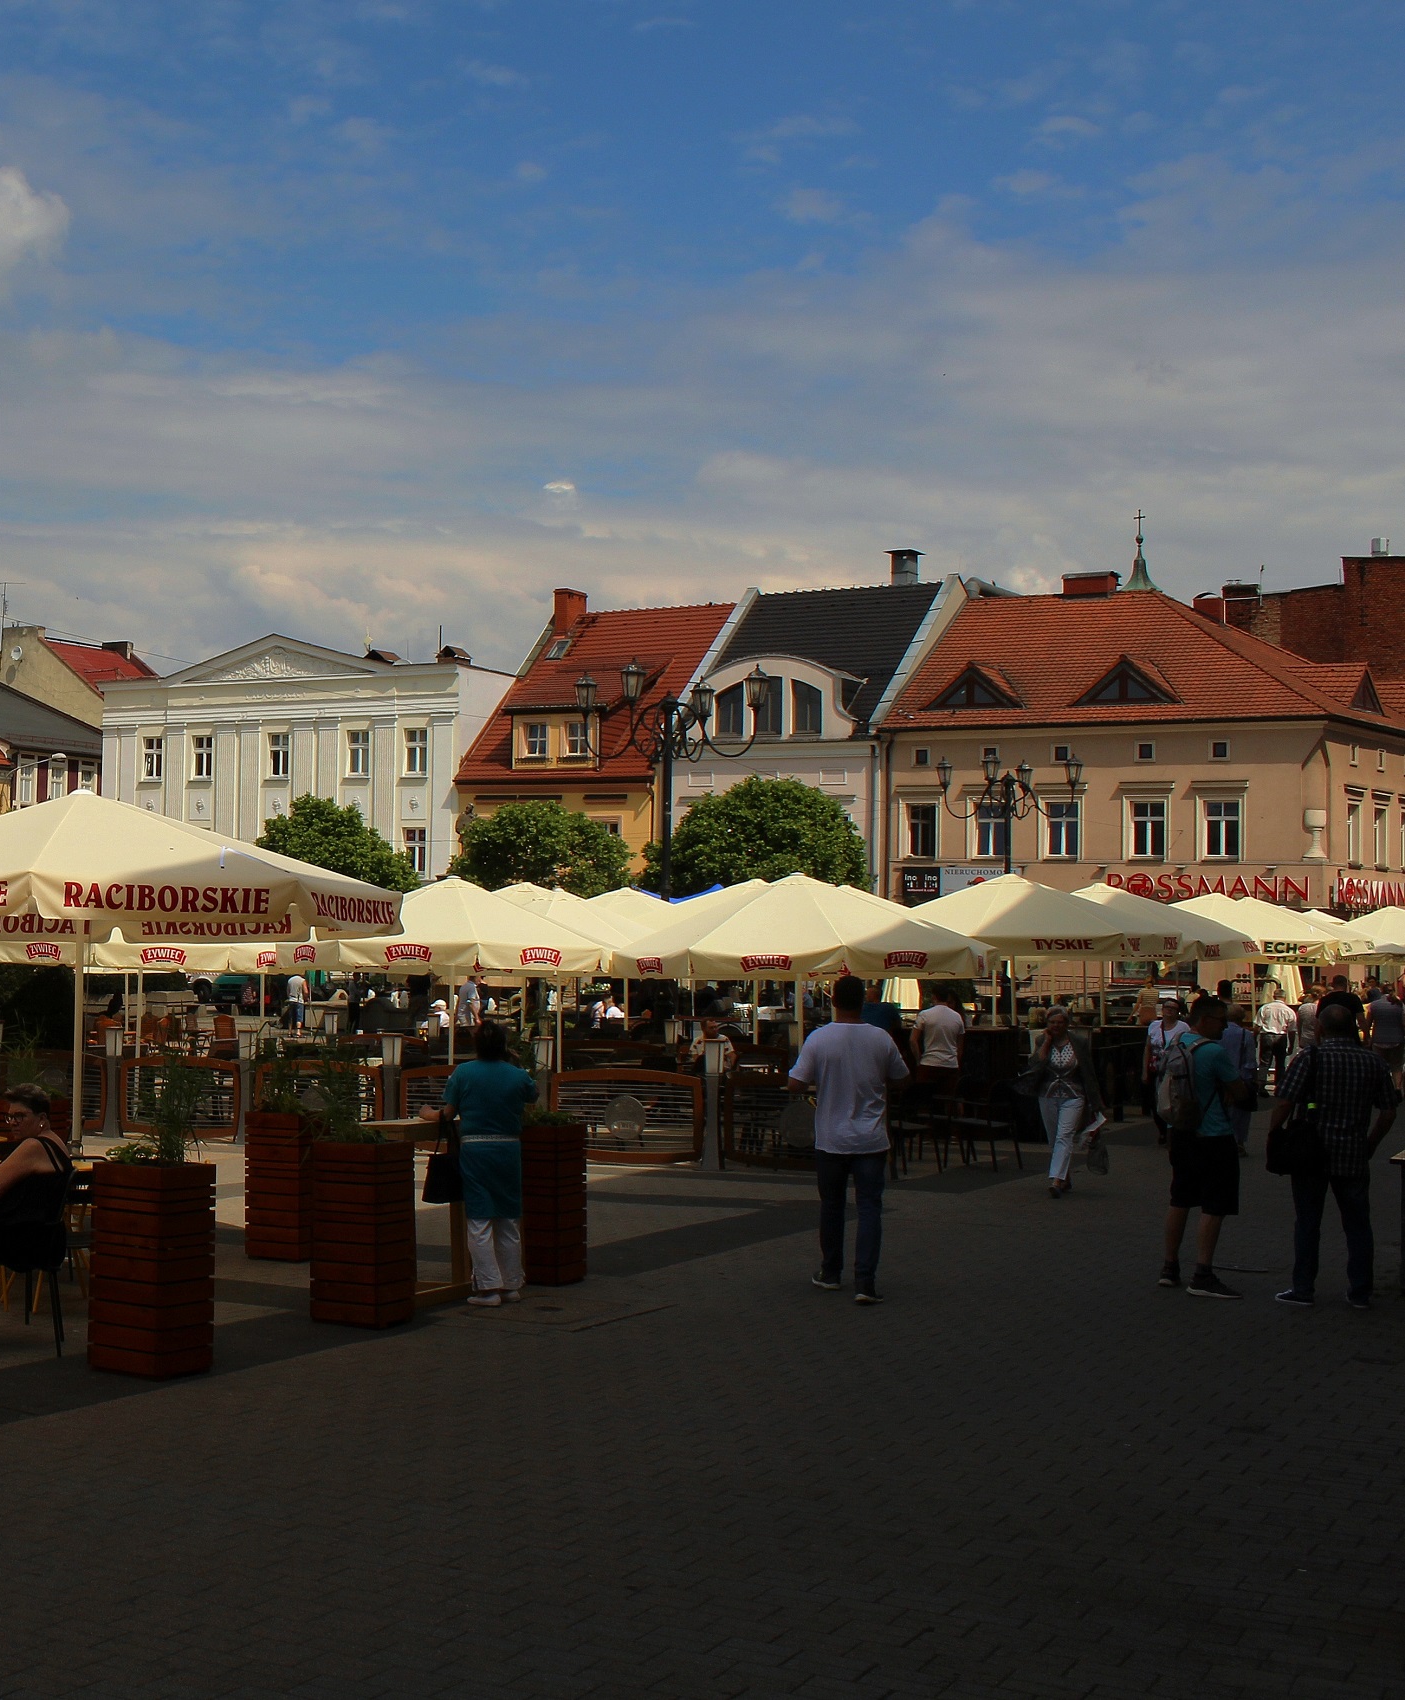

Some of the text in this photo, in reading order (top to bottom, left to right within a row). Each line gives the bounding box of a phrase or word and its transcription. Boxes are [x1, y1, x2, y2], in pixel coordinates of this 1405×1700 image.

[1107, 873, 1309, 901] ROSSMANN
[63, 881, 270, 915] RACIBORSKIE
[310, 891, 395, 926] RACIBORSKIE
[1031, 938, 1095, 951] TYSKIE
[1263, 941, 1297, 955] ECH
[147, 948, 182, 961] ŻYWIEC
[390, 945, 426, 958] ŻYWIEC
[525, 948, 558, 962] ŻYWIEC
[746, 955, 786, 968] ŻYWIEC
[890, 952, 924, 965] ŻYWIEC
